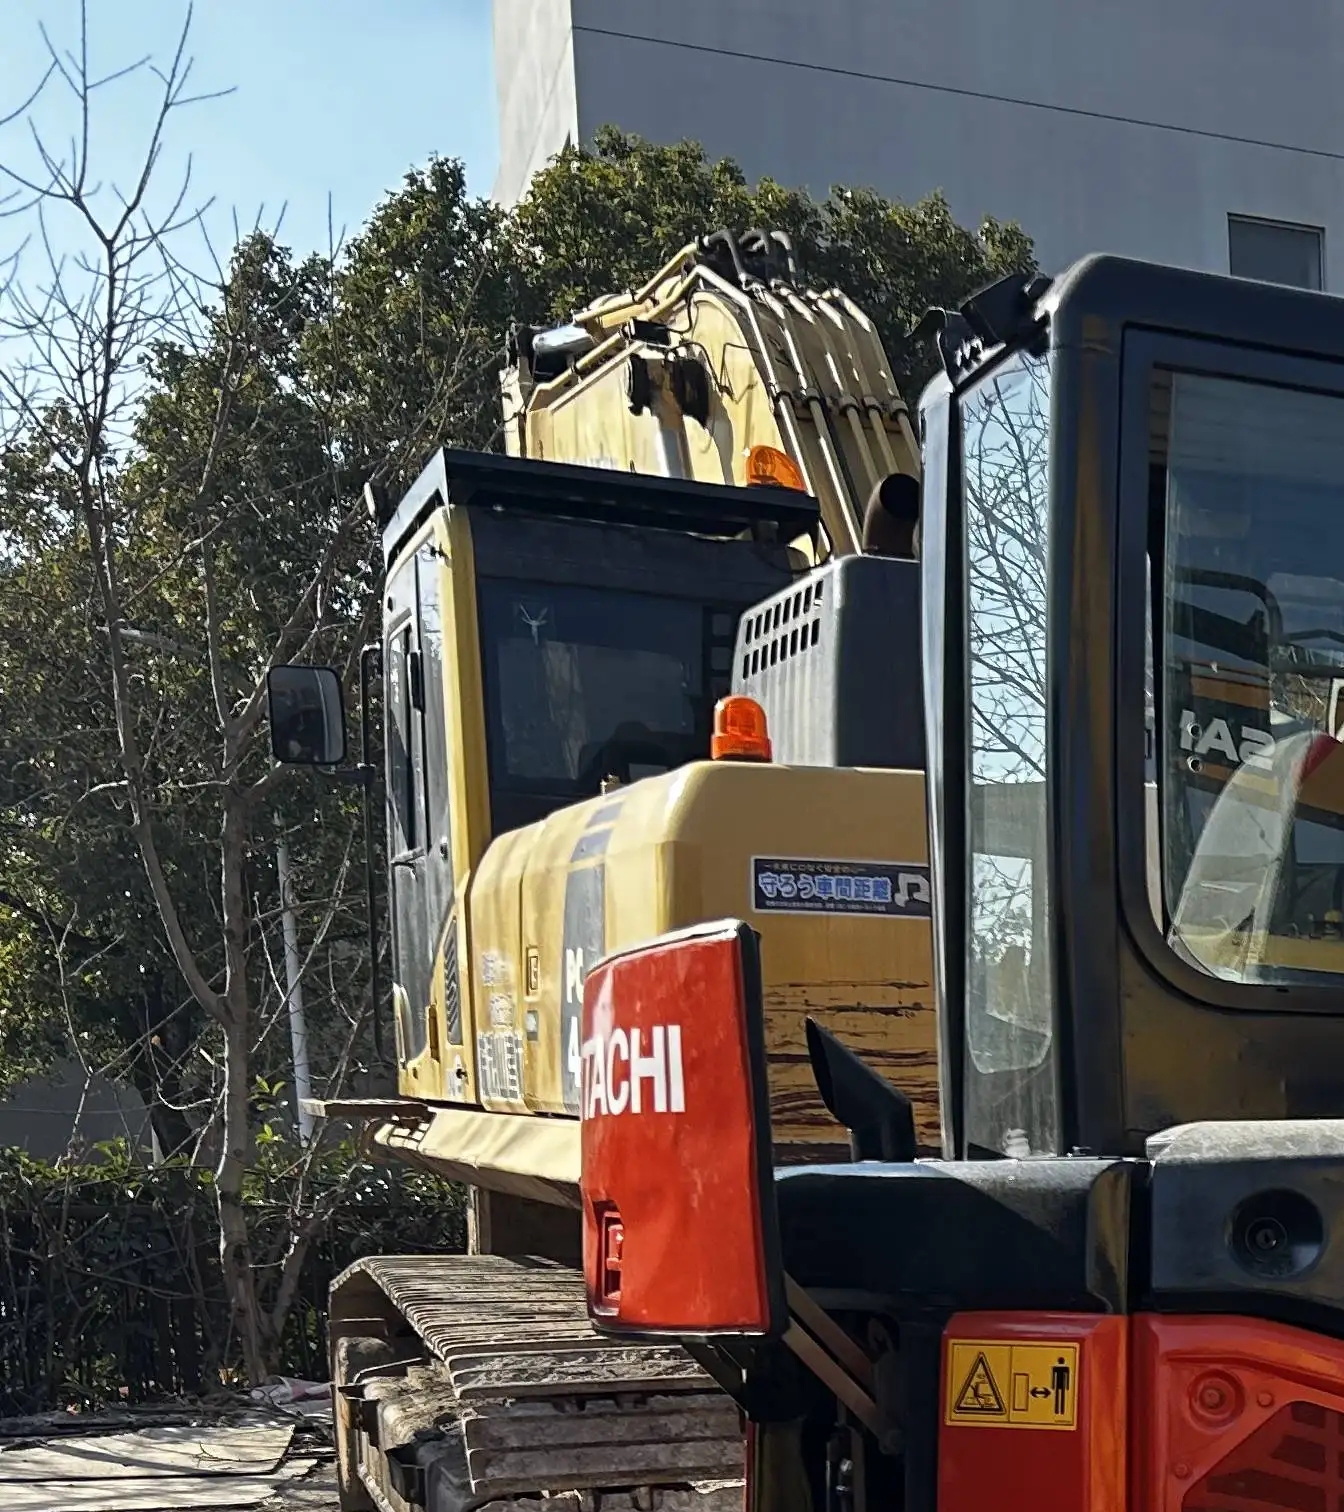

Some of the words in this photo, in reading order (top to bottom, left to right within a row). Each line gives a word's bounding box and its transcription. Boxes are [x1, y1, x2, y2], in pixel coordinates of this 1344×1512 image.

[758, 872, 892, 902] 守ろう車間距離
